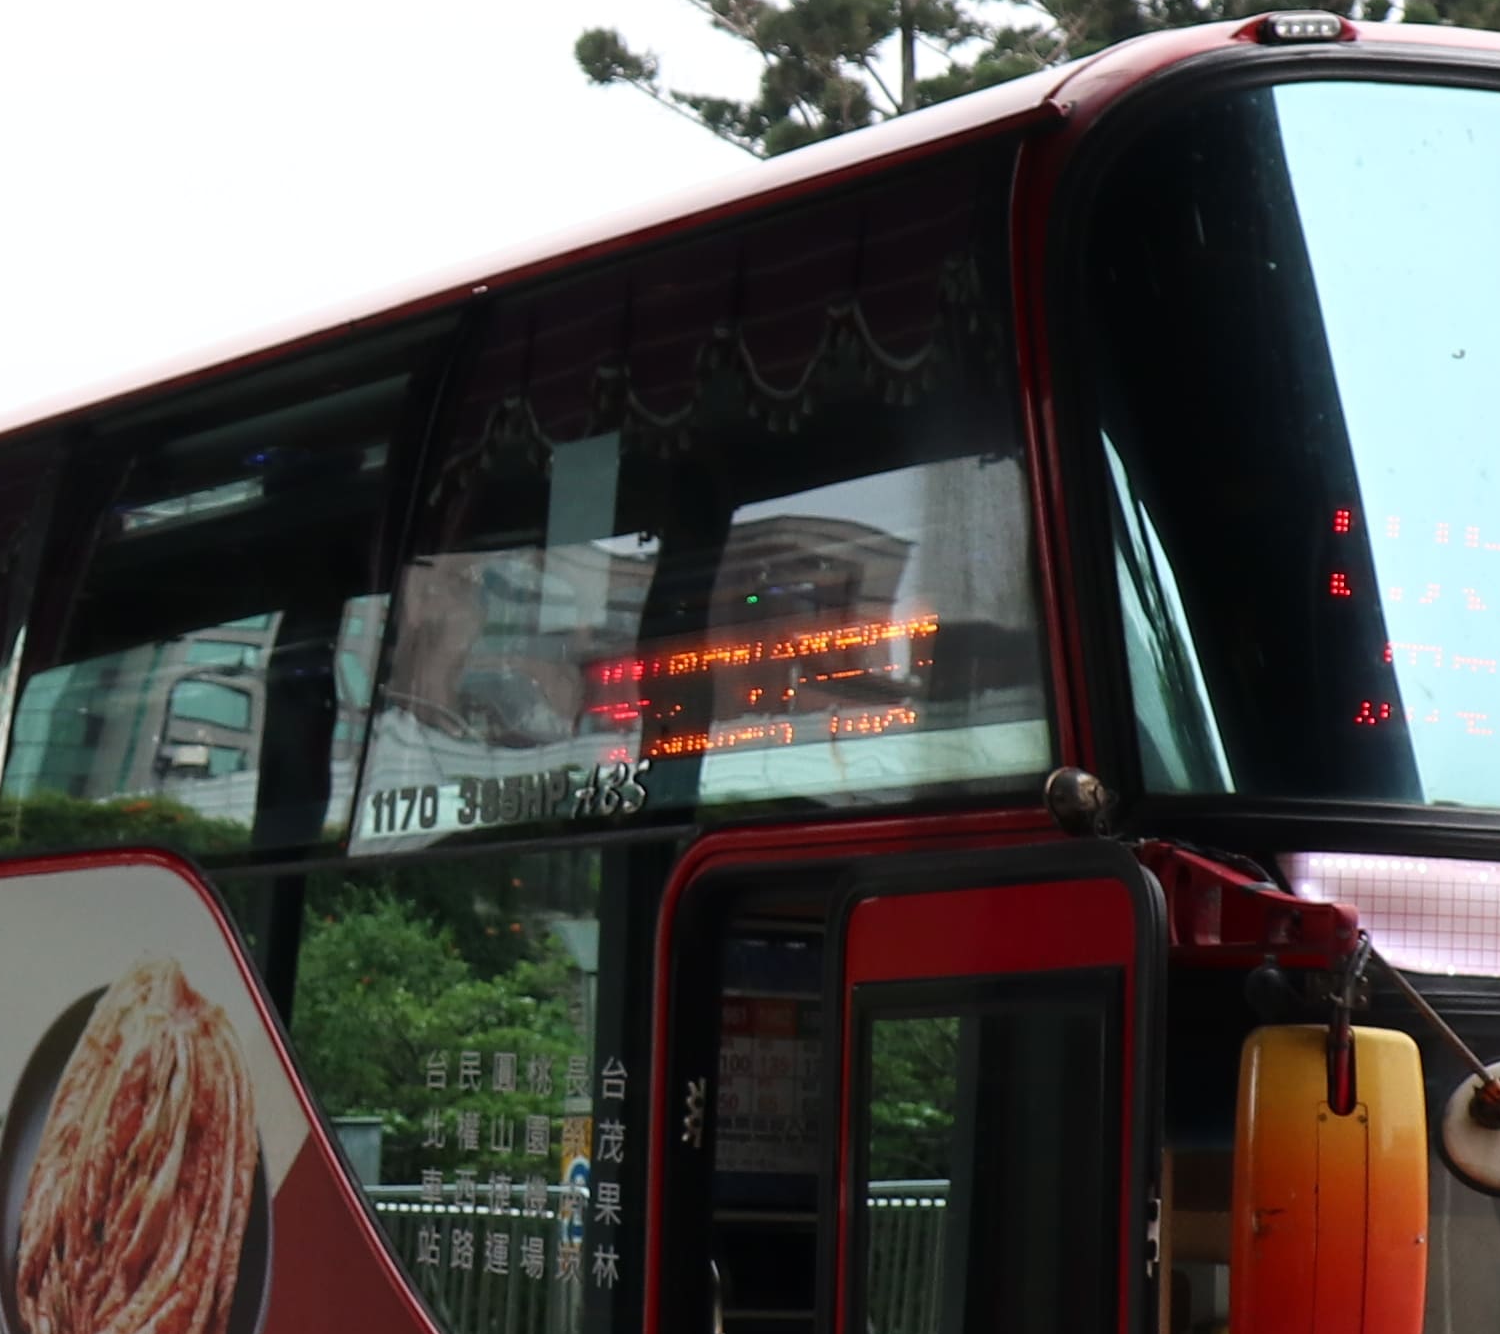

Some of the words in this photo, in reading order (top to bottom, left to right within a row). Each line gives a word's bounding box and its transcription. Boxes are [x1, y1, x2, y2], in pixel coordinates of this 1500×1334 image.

[372, 786, 438, 833] 1170
[573, 759, 652, 819] ABS
[417, 1050, 447, 1267] 台北車站
[451, 1051, 482, 1270] 民權西路
[520, 1053, 553, 1279] 桃園機場
[592, 1056, 628, 1289] 台茂果林
